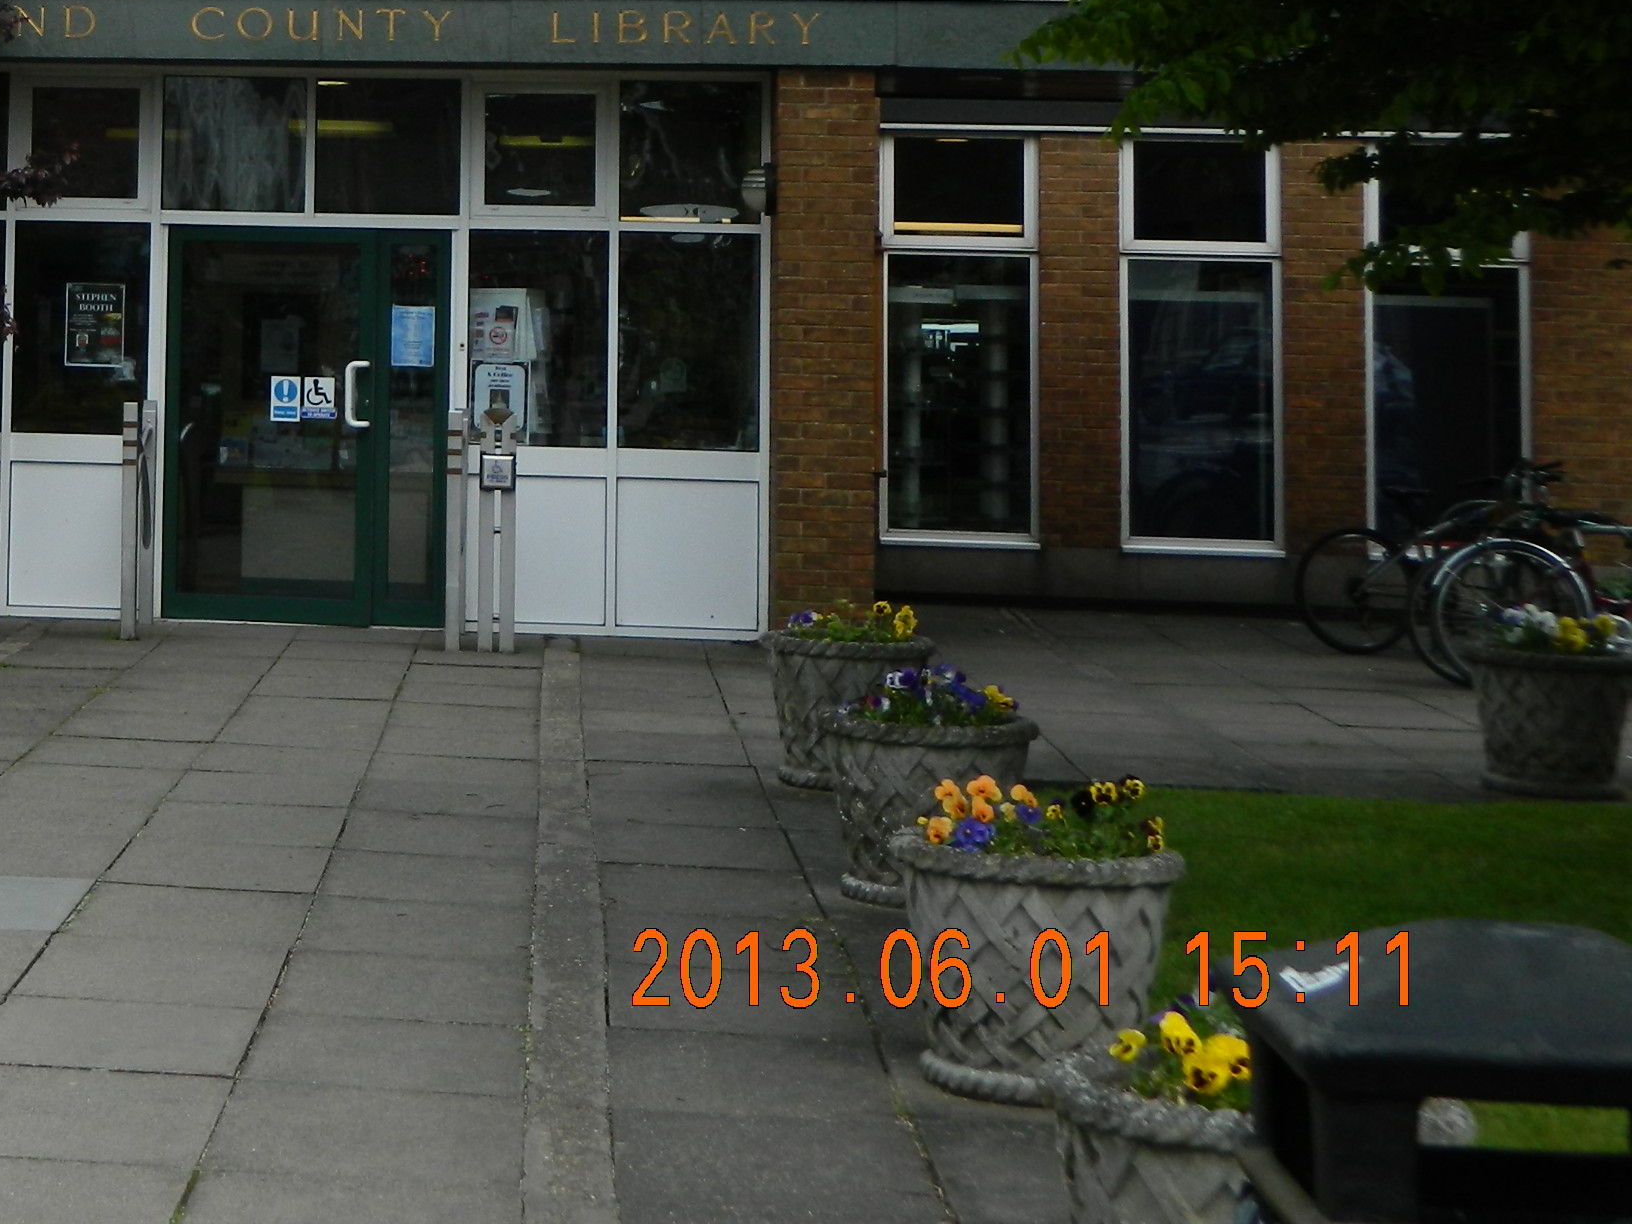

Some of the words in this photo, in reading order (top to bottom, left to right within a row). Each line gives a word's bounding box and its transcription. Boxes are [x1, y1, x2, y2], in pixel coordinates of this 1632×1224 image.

[191, 6, 452, 41] COUNTY
[551, 9, 821, 44] LIBRARY
[76, 293, 116, 301] STEPHEN
[79, 303, 113, 311] BOOTH
